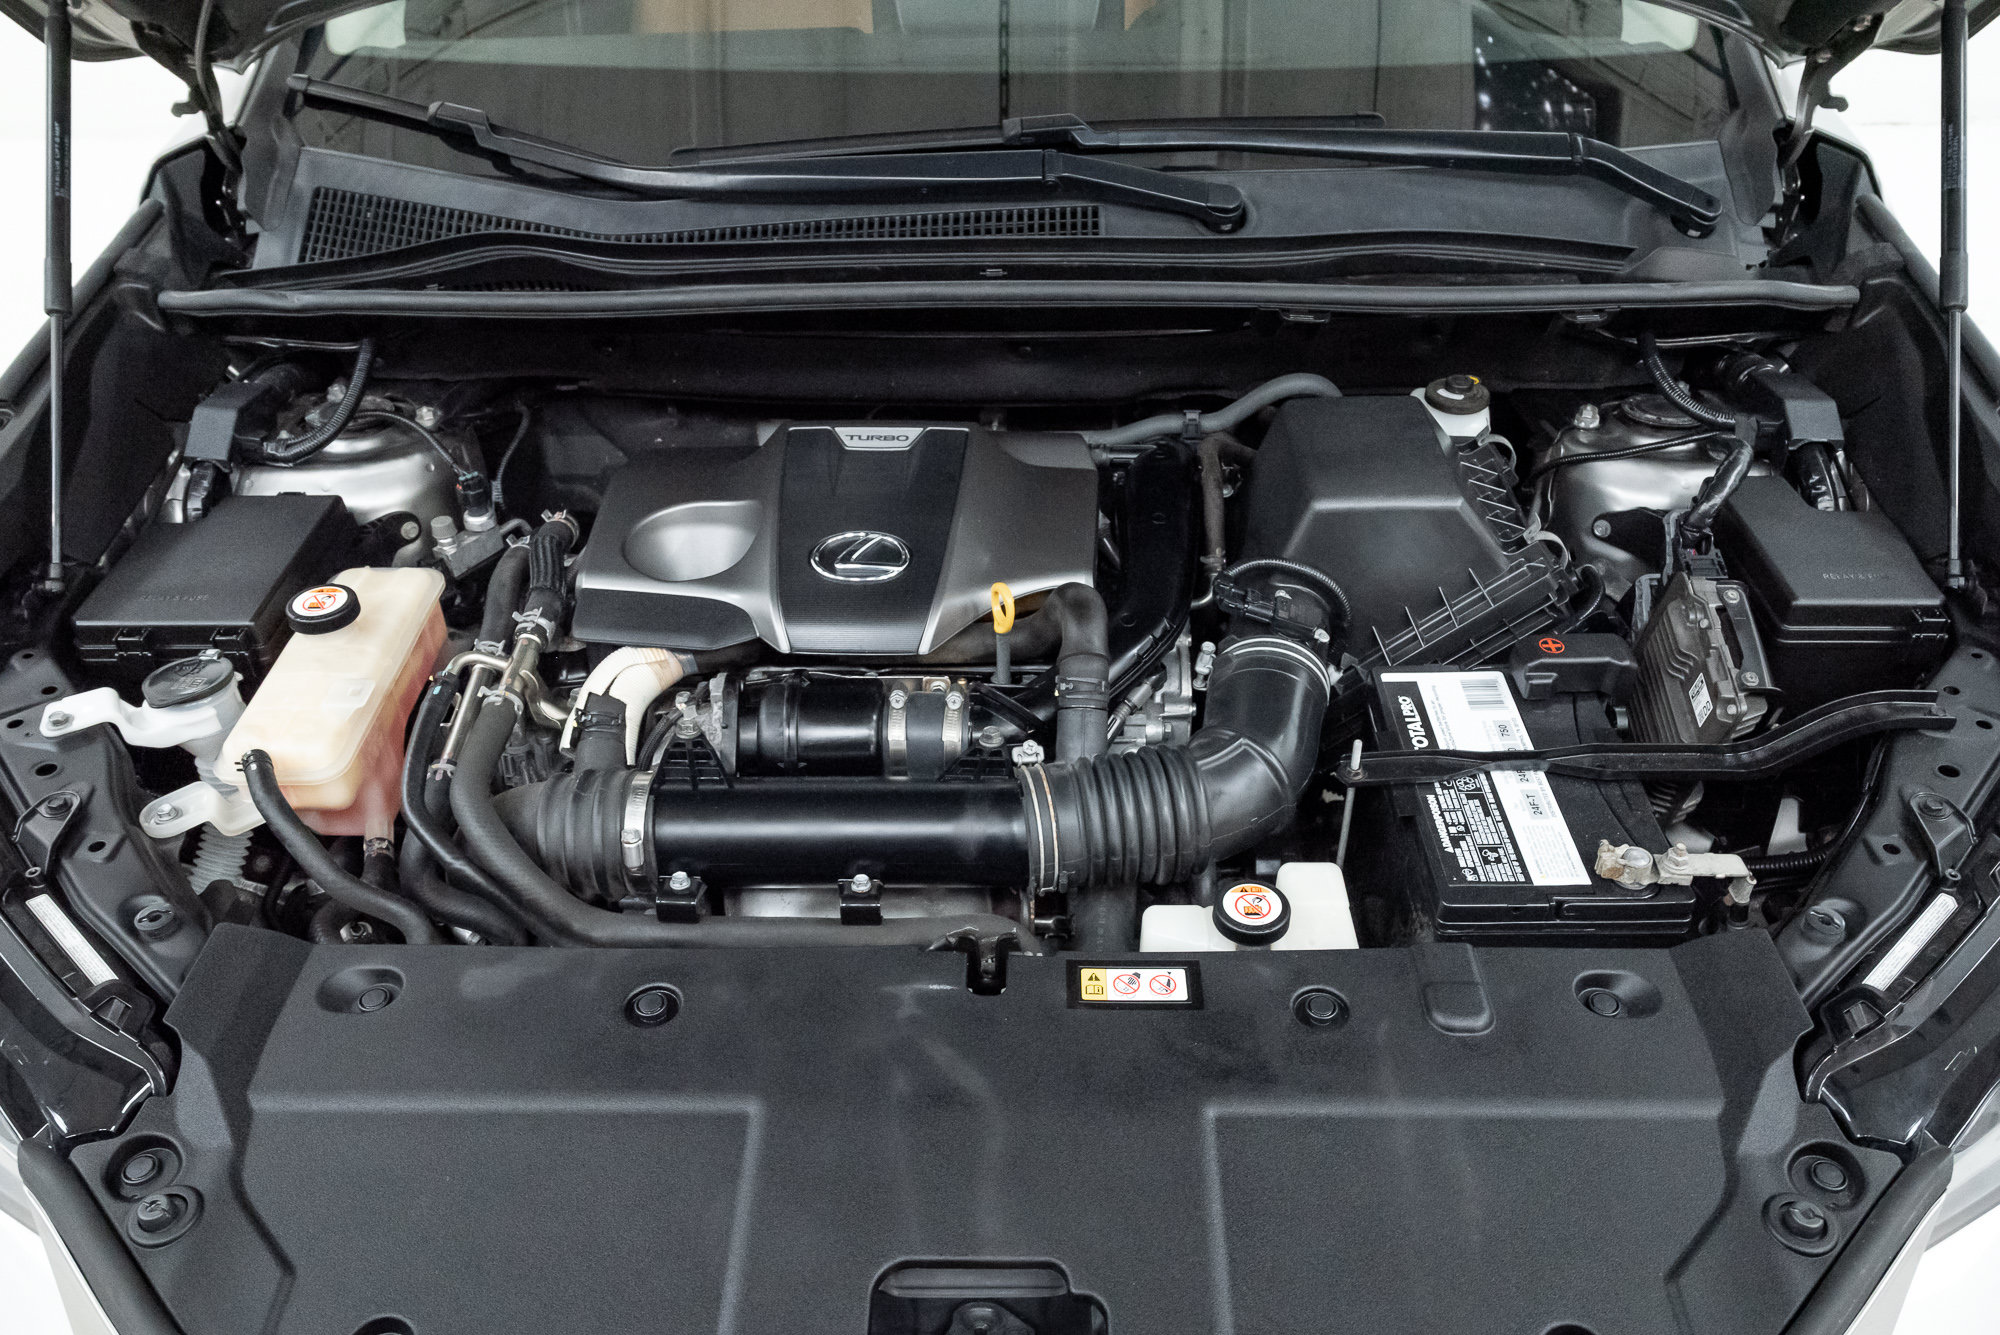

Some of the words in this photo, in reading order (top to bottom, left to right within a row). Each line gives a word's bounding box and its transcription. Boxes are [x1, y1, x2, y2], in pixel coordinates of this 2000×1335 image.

[845, 434, 910, 442] TURBO
[1397, 695, 1431, 750] OTALPRO
[1498, 724, 1511, 737] 750
[1526, 794, 1543, 815] 24F-T
